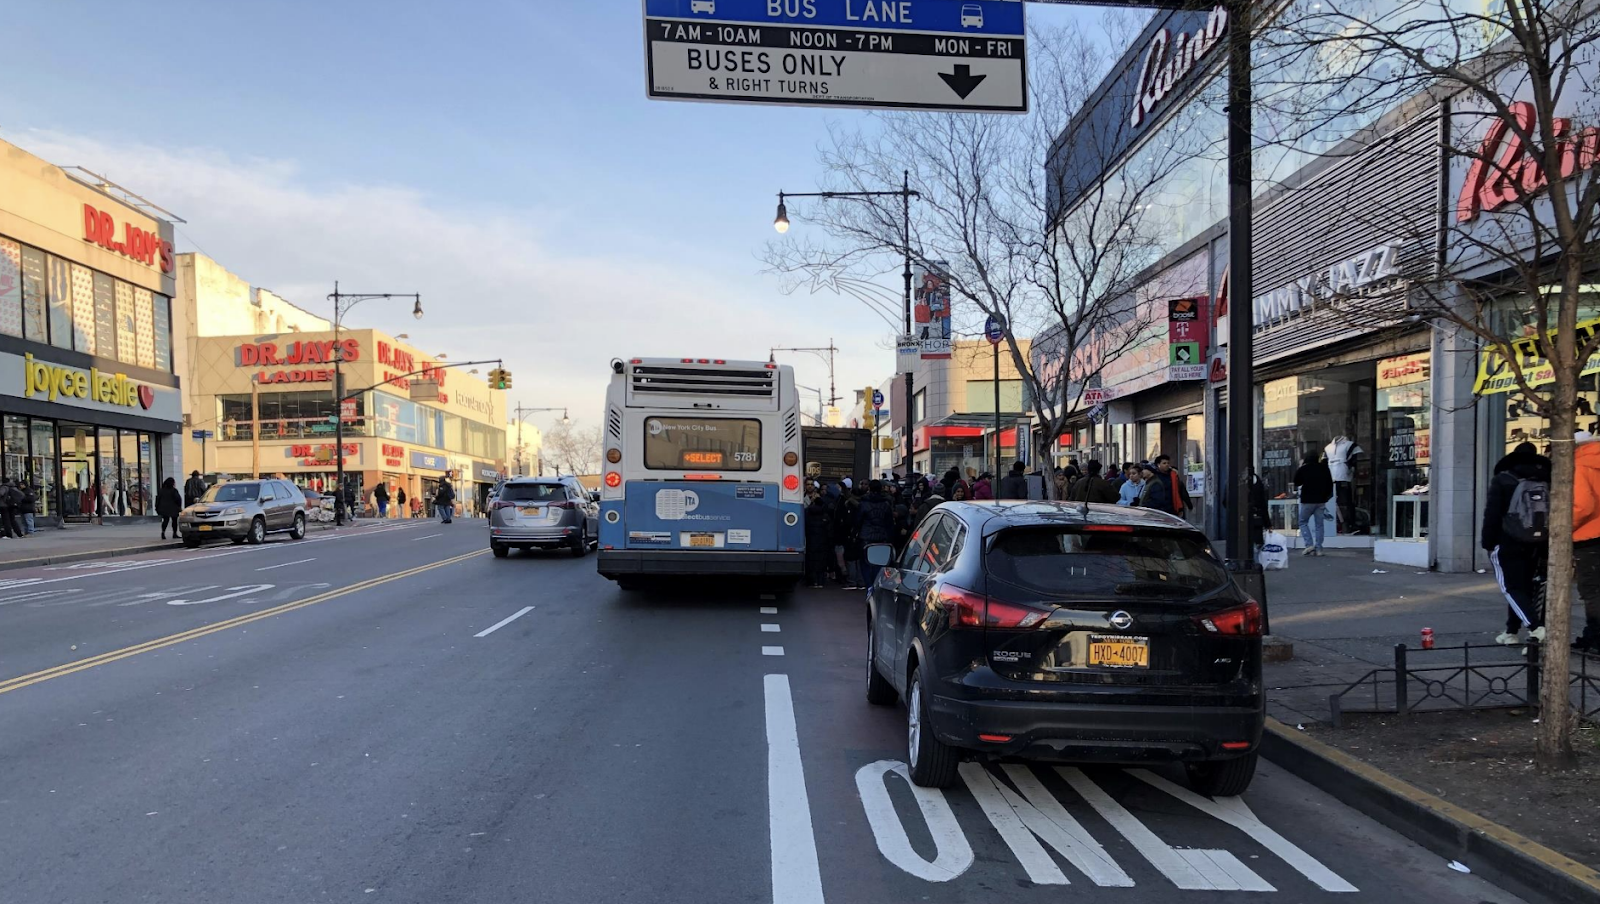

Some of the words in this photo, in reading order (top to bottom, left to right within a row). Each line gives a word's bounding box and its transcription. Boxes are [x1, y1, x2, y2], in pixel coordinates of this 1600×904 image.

[767, 0, 817, 18] BUS
[845, 0, 913, 23] LANE
[789, 30, 837, 48] NOON
[687, 48, 771, 74] BUSES
[782, 53, 847, 76] ONLY
[709, 76, 720, 90] &
[726, 78, 771, 92] RIGHT
[778, 80, 829, 94] TURNS
[1252, 281, 1319, 326] IMMY
[1322, 239, 1404, 298] JAZZ
[1172, 311, 1195, 319] boost
[25, 352, 89, 402] joyce
[90, 366, 138, 407] leslie
[692, 424, 704, 432] City
[734, 452, 757, 462] 5781
[1389, 446, 1408, 461] 25%
[806, 466, 821, 477] ups
[993, 650, 1032, 659] ROGUE
